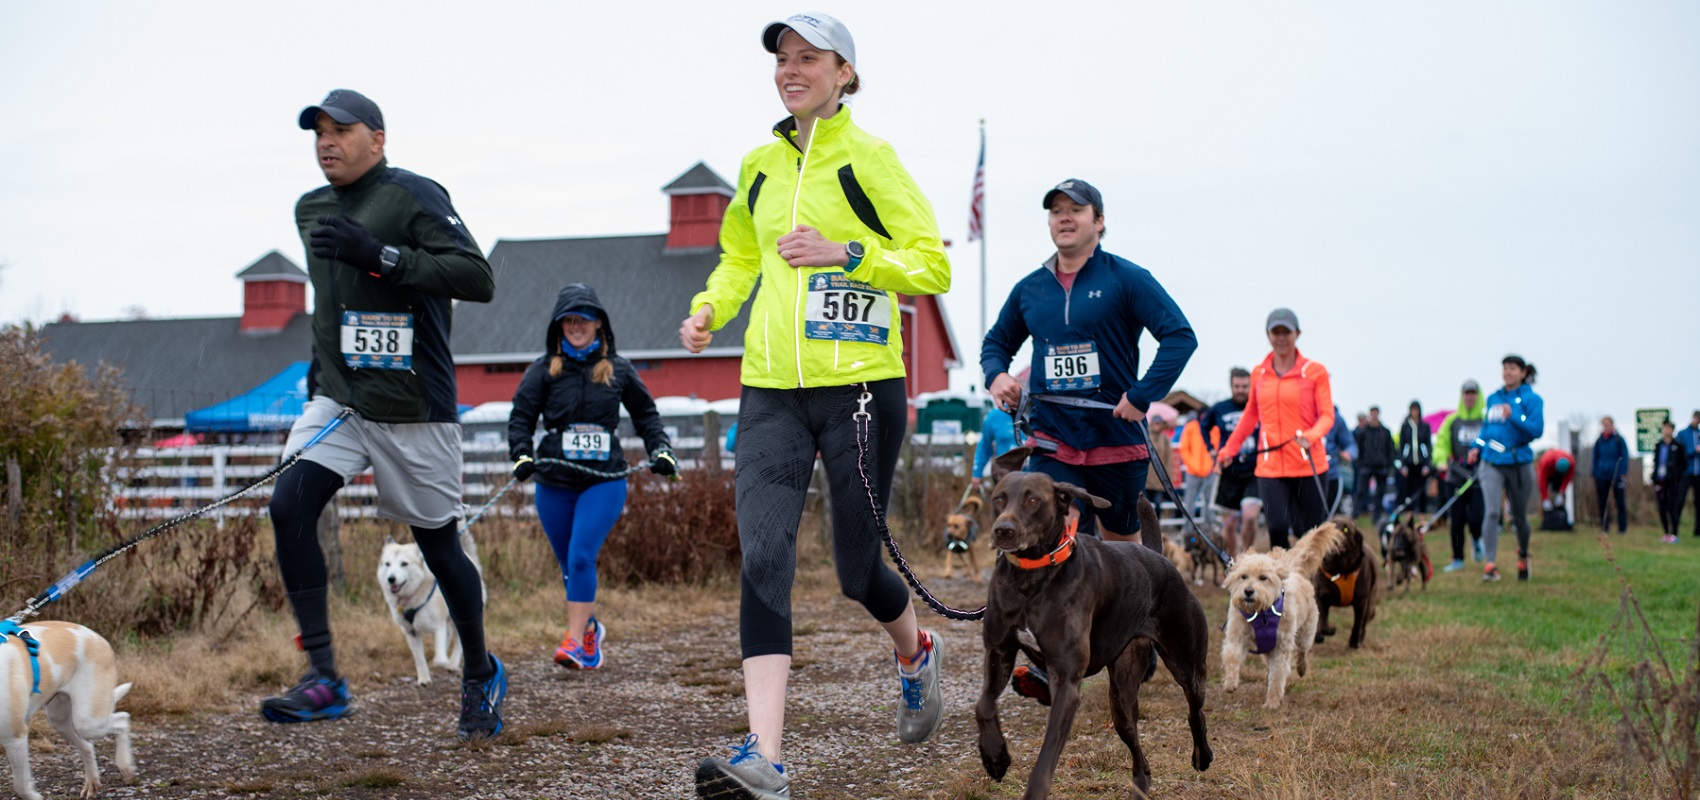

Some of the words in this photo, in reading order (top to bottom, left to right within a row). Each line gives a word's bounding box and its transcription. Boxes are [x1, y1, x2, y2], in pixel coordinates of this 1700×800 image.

[823, 292, 876, 322] 567
[355, 329, 400, 353] 538
[1054, 356, 1088, 377] 596
[572, 434, 602, 449] 439
